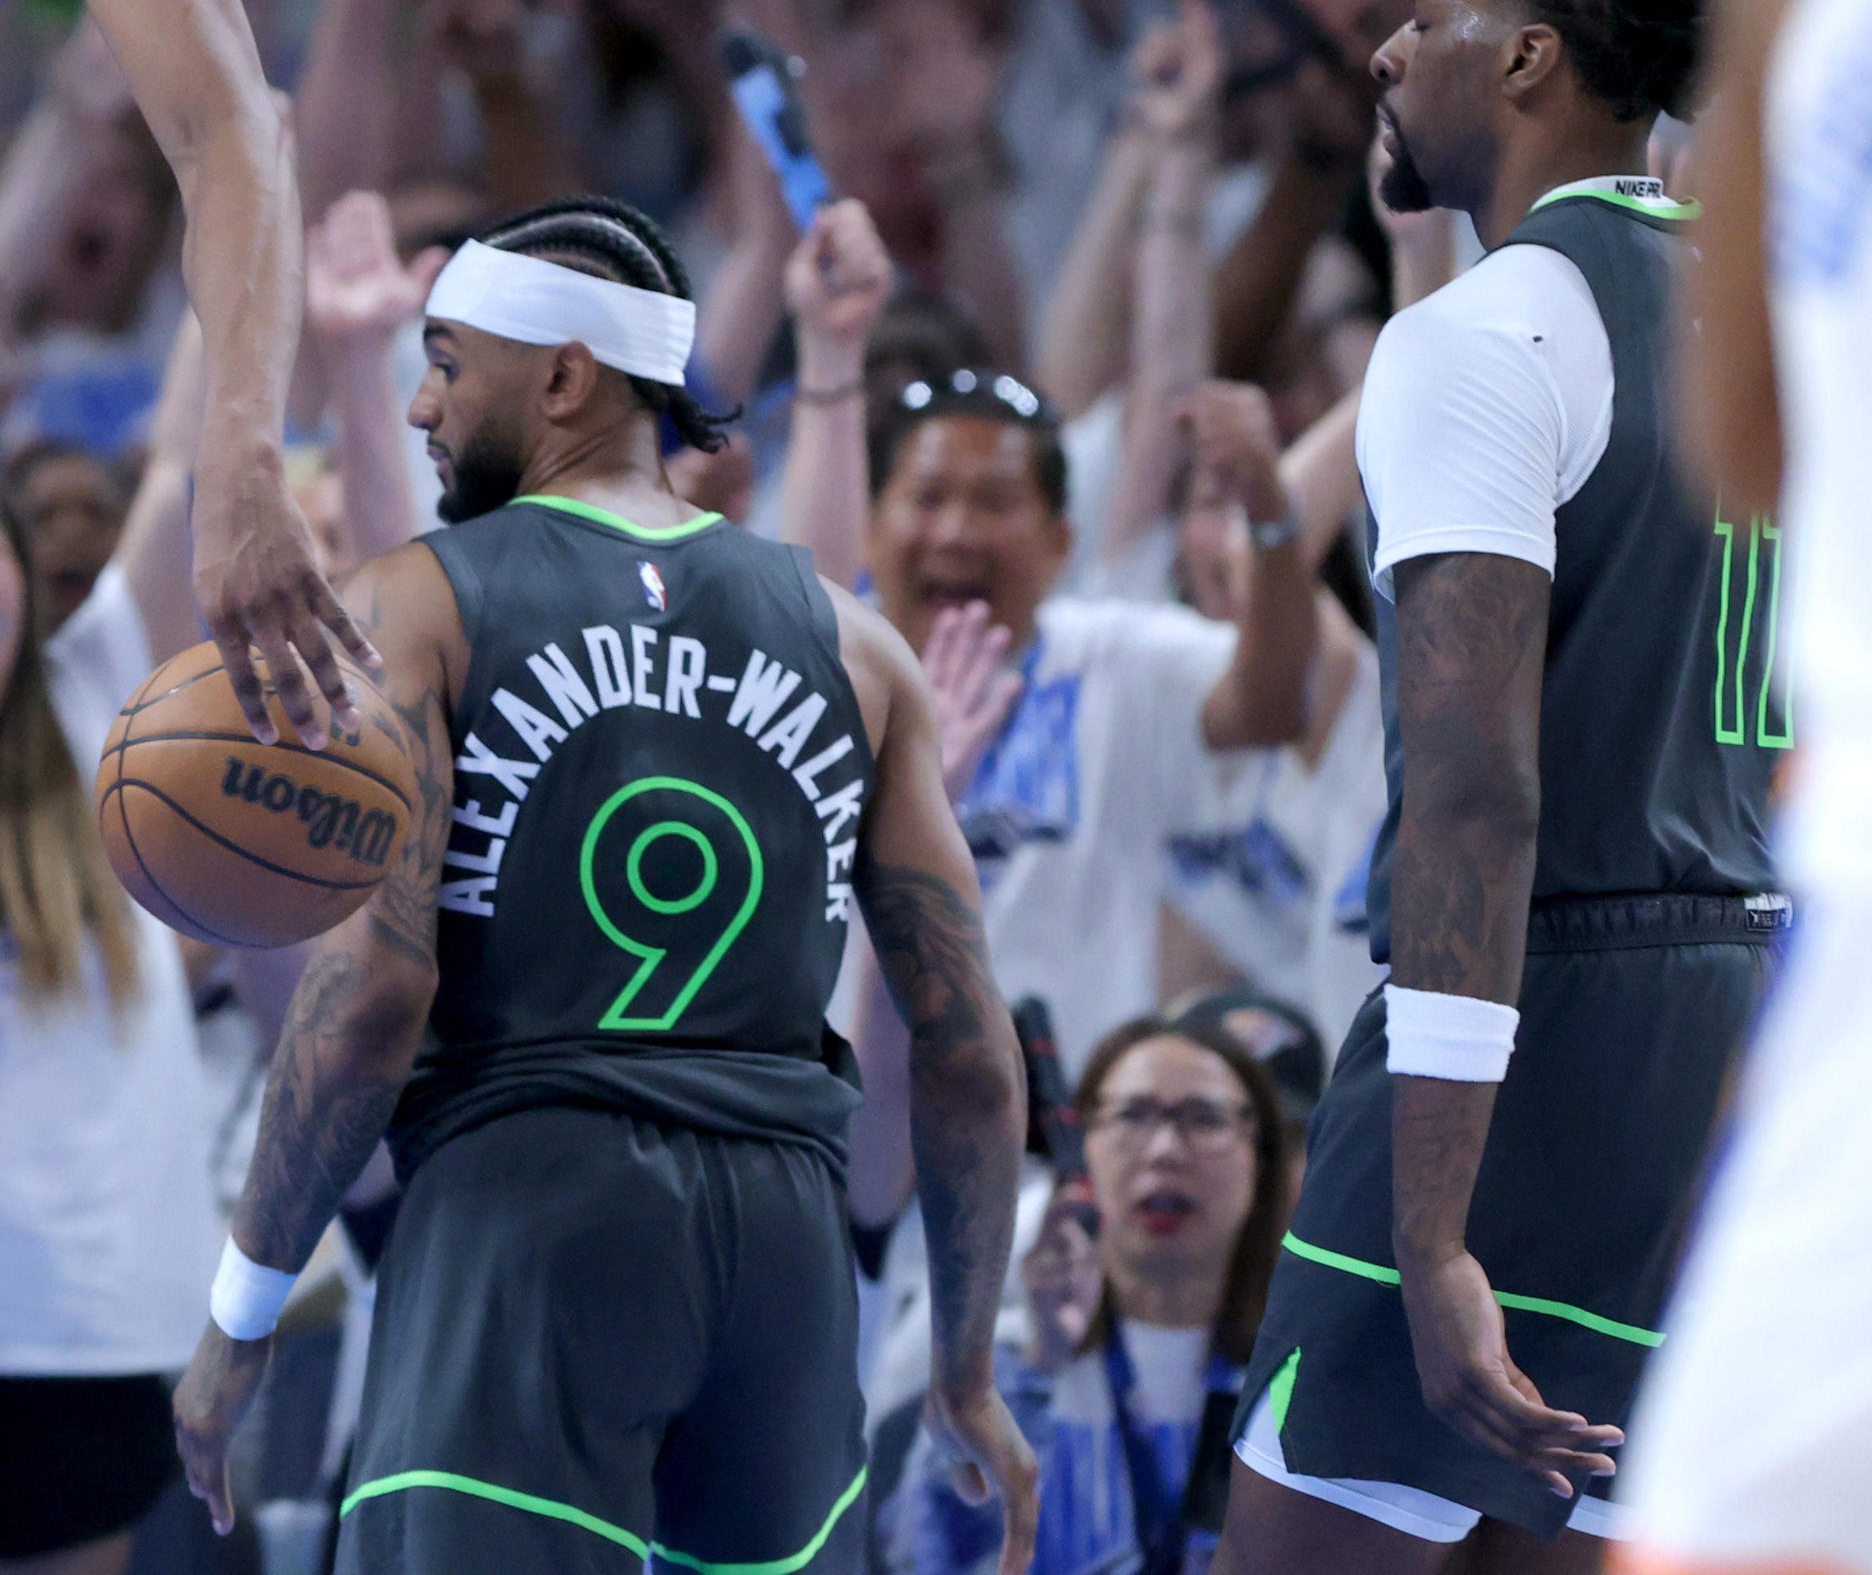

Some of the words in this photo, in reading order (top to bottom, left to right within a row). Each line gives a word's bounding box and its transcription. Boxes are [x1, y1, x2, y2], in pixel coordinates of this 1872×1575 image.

[1615, 180, 1646, 197] NIKE
[222, 755, 397, 867] Wilson
[437, 624, 865, 923] ALEXANDER-WALKER
[580, 775, 764, 1031] 9
